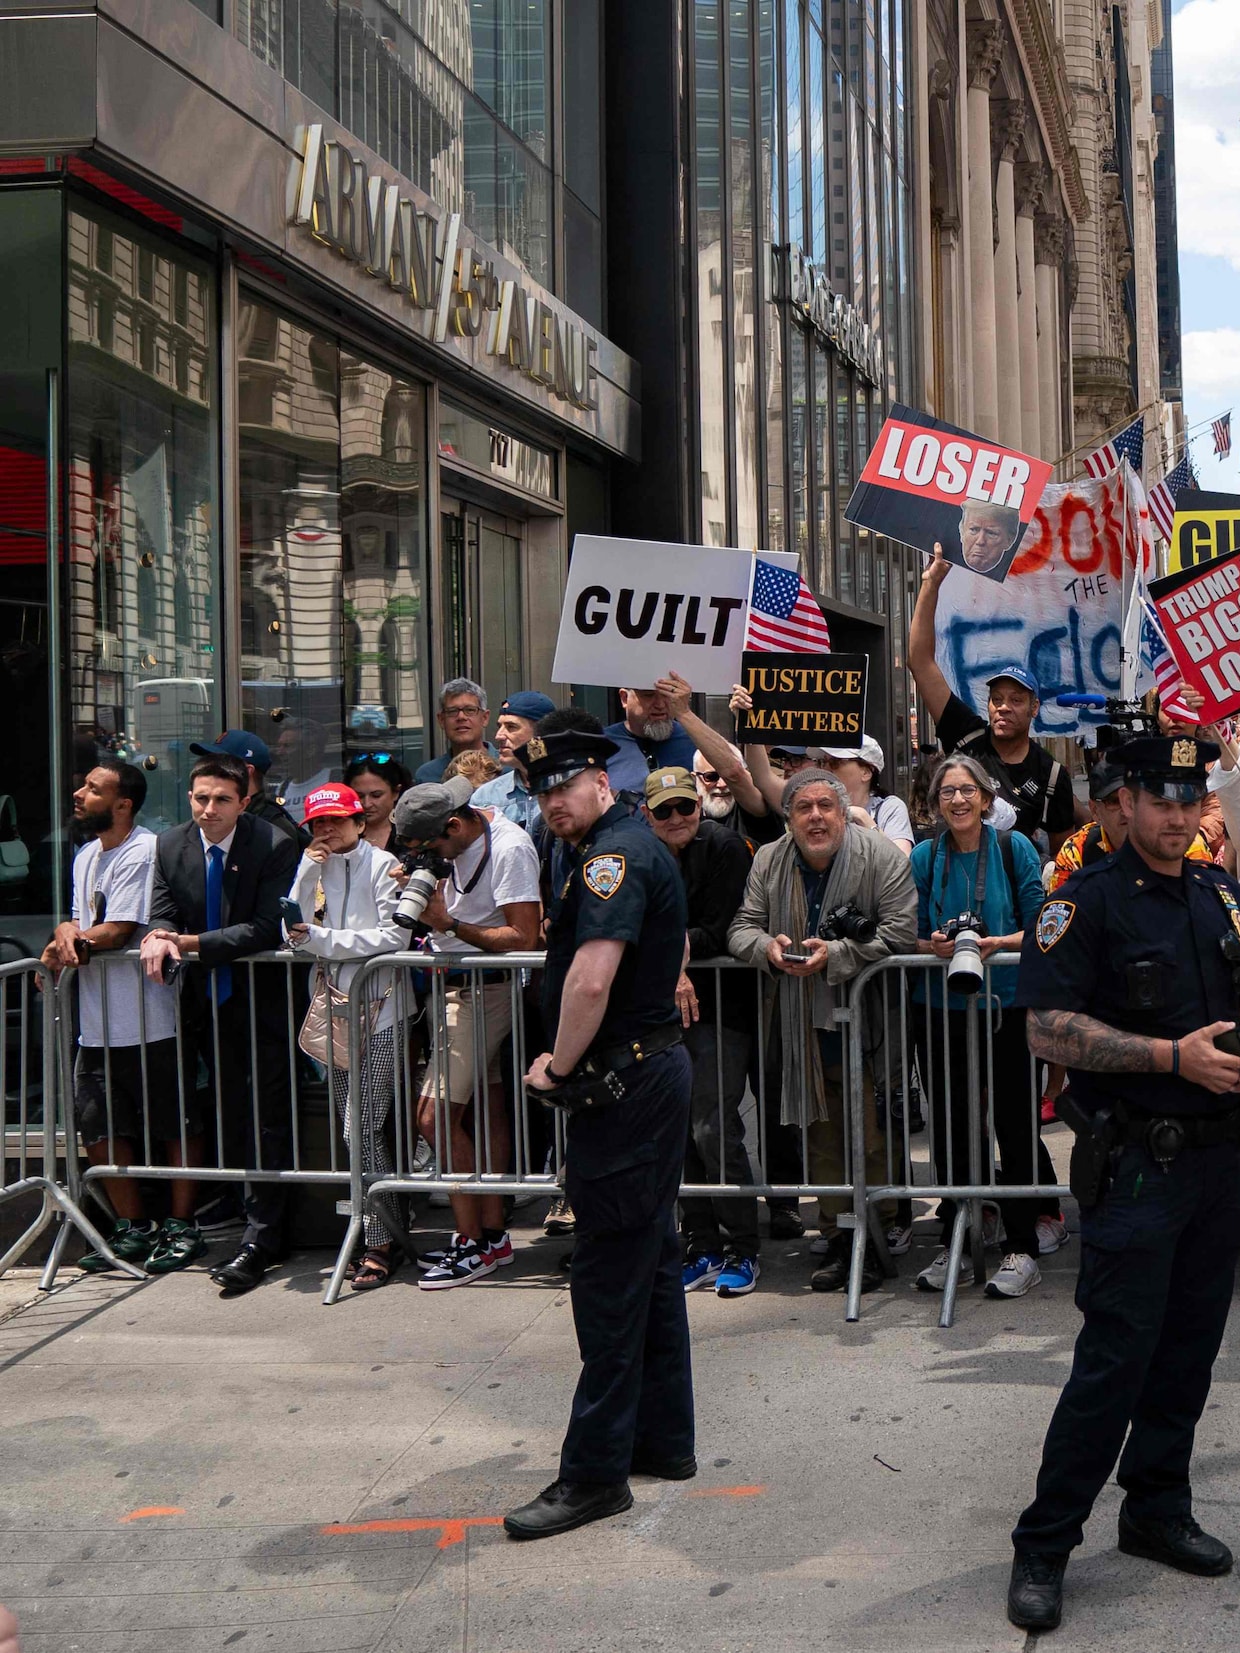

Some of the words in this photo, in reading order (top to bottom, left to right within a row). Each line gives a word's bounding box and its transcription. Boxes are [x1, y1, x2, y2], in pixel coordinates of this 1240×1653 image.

[878, 427, 1030, 510] LOSER
[1064, 573, 1110, 603] THE
[1160, 564, 1240, 625] TRUMP
[574, 585, 748, 646] GUILT
[746, 668, 862, 695] JUSTICE
[745, 709, 860, 734] MATTERS
